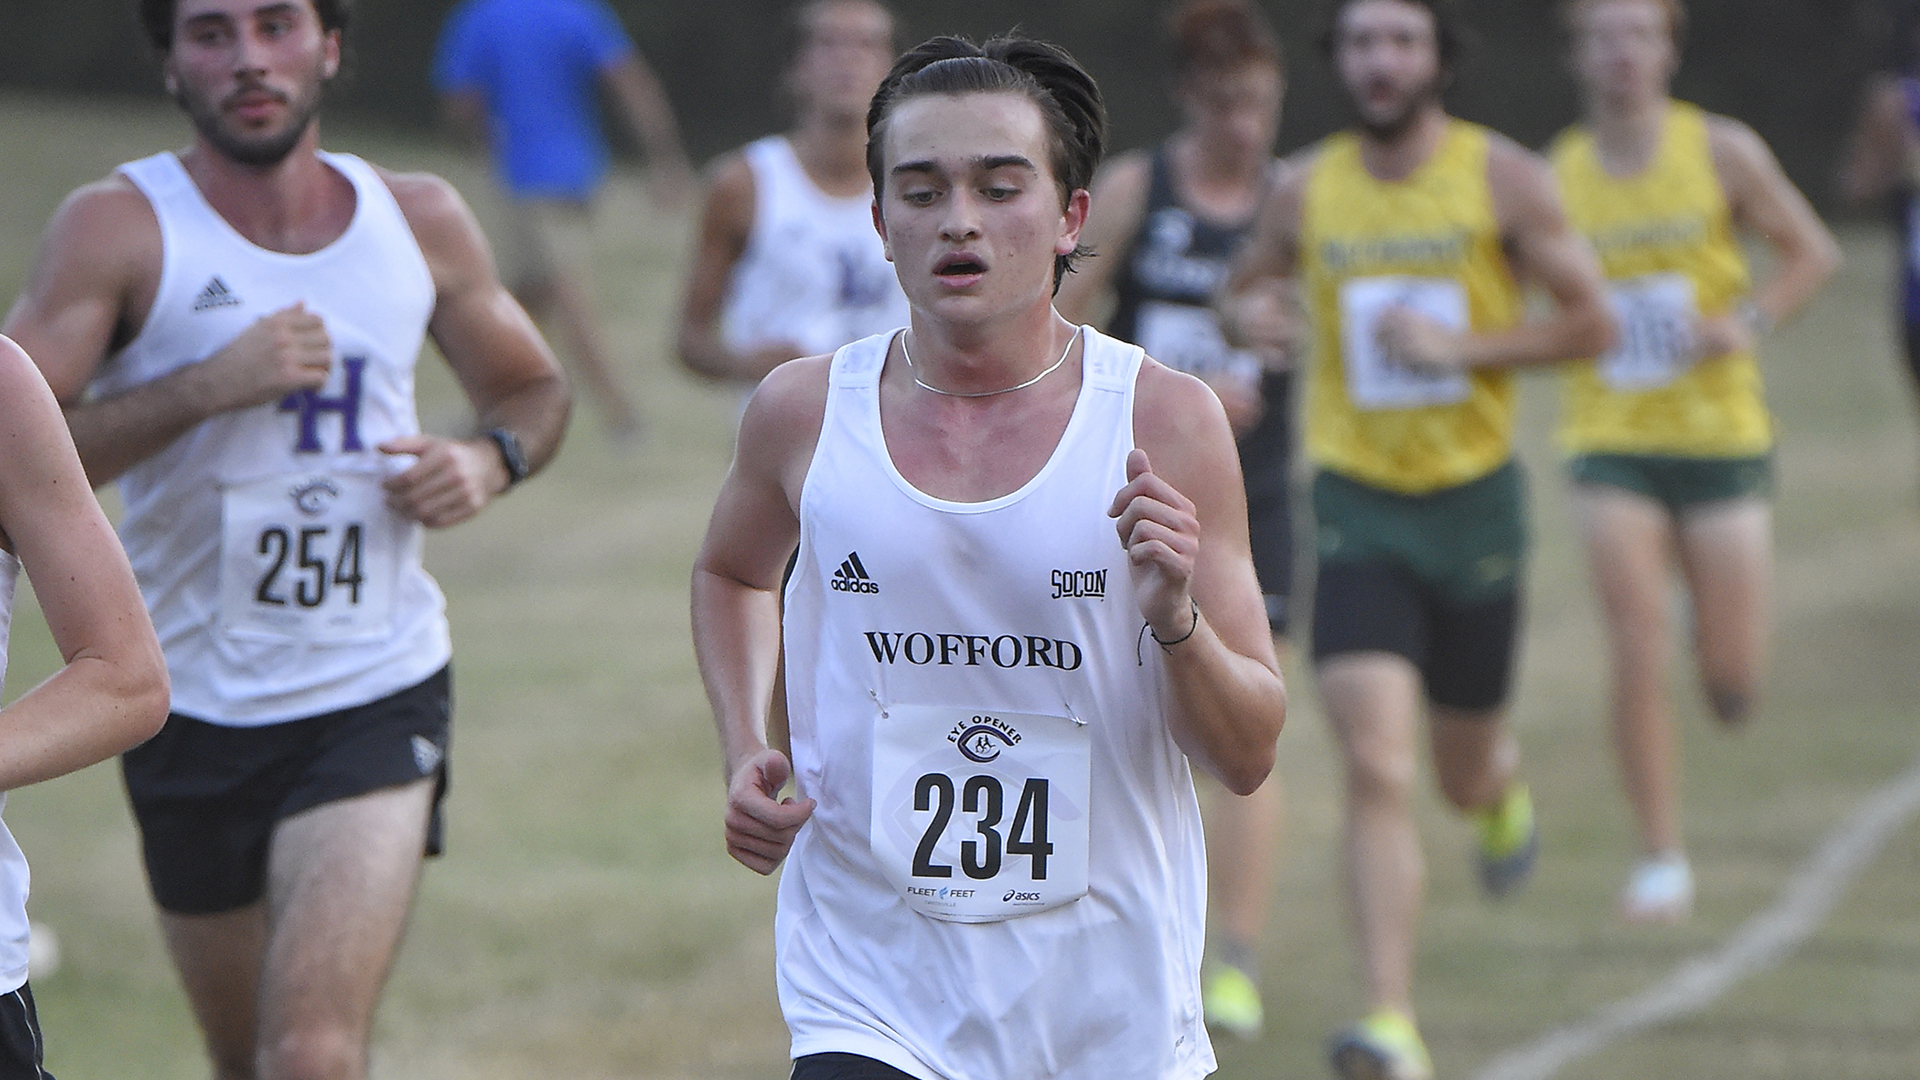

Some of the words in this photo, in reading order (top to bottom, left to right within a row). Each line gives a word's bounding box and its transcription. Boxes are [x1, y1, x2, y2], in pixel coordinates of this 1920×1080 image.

[257, 524, 362, 608] 254
[831, 577, 880, 594] adidas
[863, 631, 1083, 671] WOFFORD
[947, 720, 967, 743] EYE
[972, 715, 1022, 744] OPENER
[911, 772, 1054, 881] 234
[907, 886, 937, 898] FLEET
[950, 889, 975, 899] FEET
[1014, 891, 1041, 902] asics
